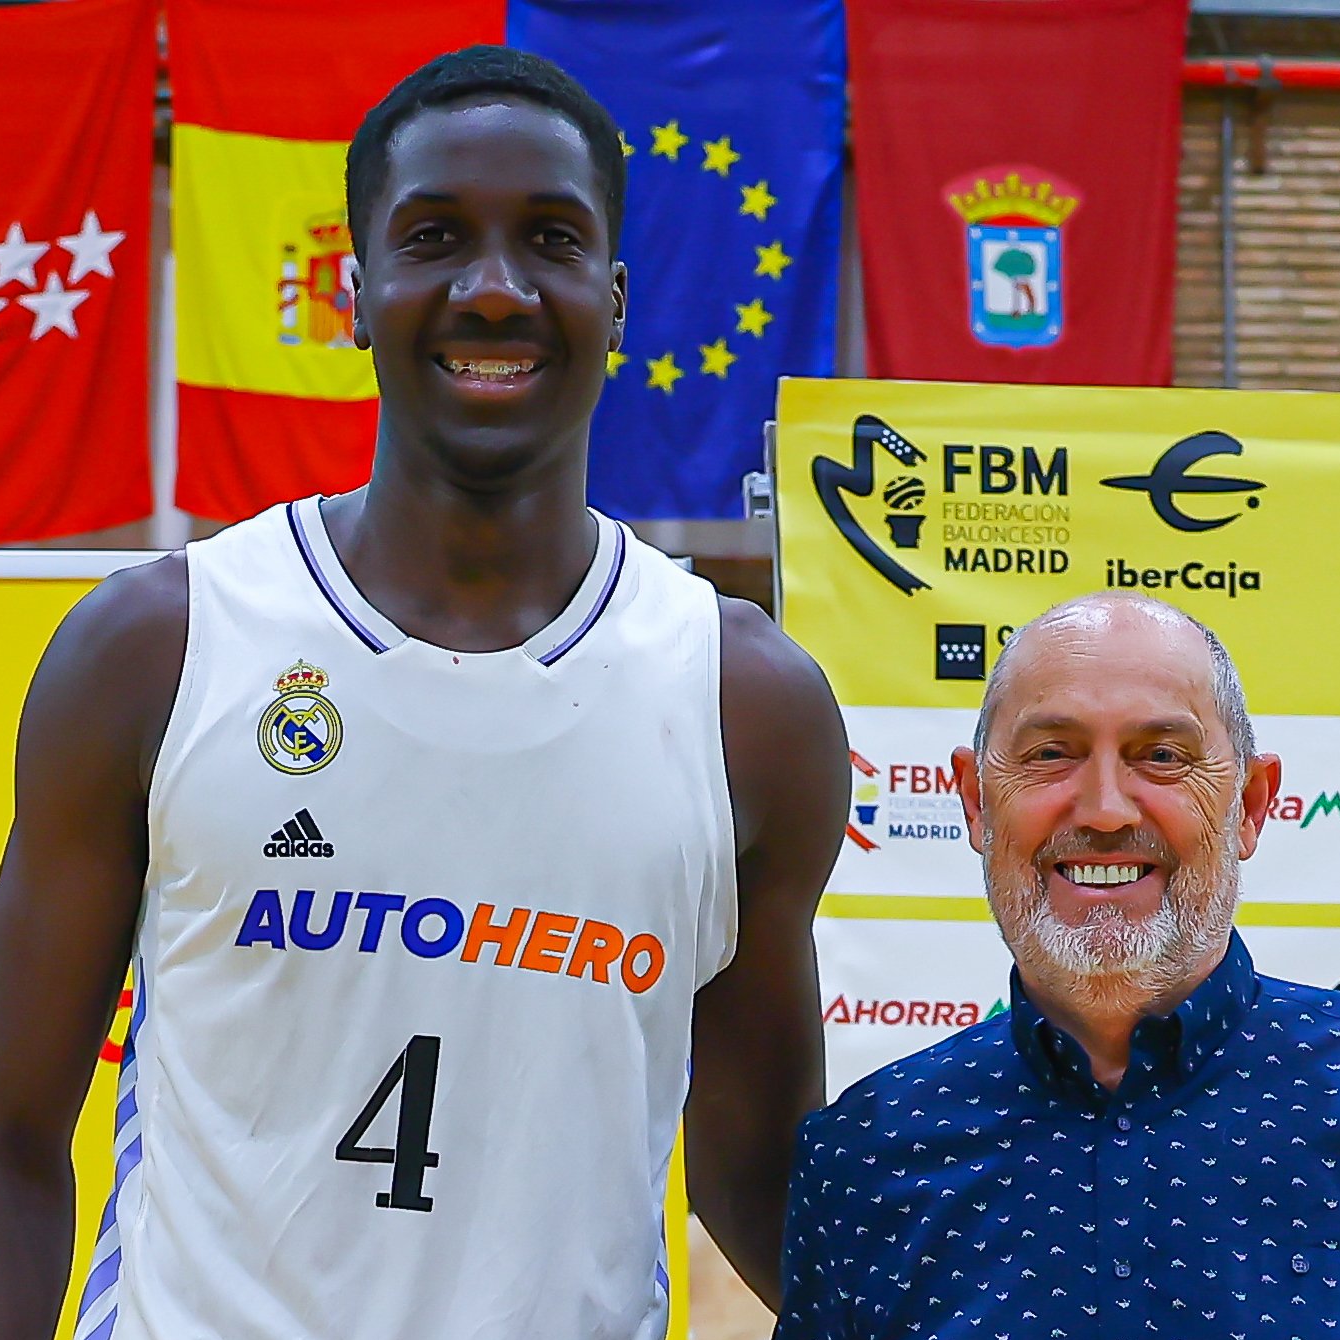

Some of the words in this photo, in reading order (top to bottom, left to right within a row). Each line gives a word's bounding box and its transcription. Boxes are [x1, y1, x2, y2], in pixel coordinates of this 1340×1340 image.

[941, 443, 1070, 497] FBM
[941, 524, 1072, 545] BALONCESTO
[943, 546, 1070, 576] MADRID
[887, 823, 963, 840] MADRID
[263, 839, 335, 858] adidas
[234, 888, 665, 994] AUTOHERO
[333, 1034, 442, 1213] 4
